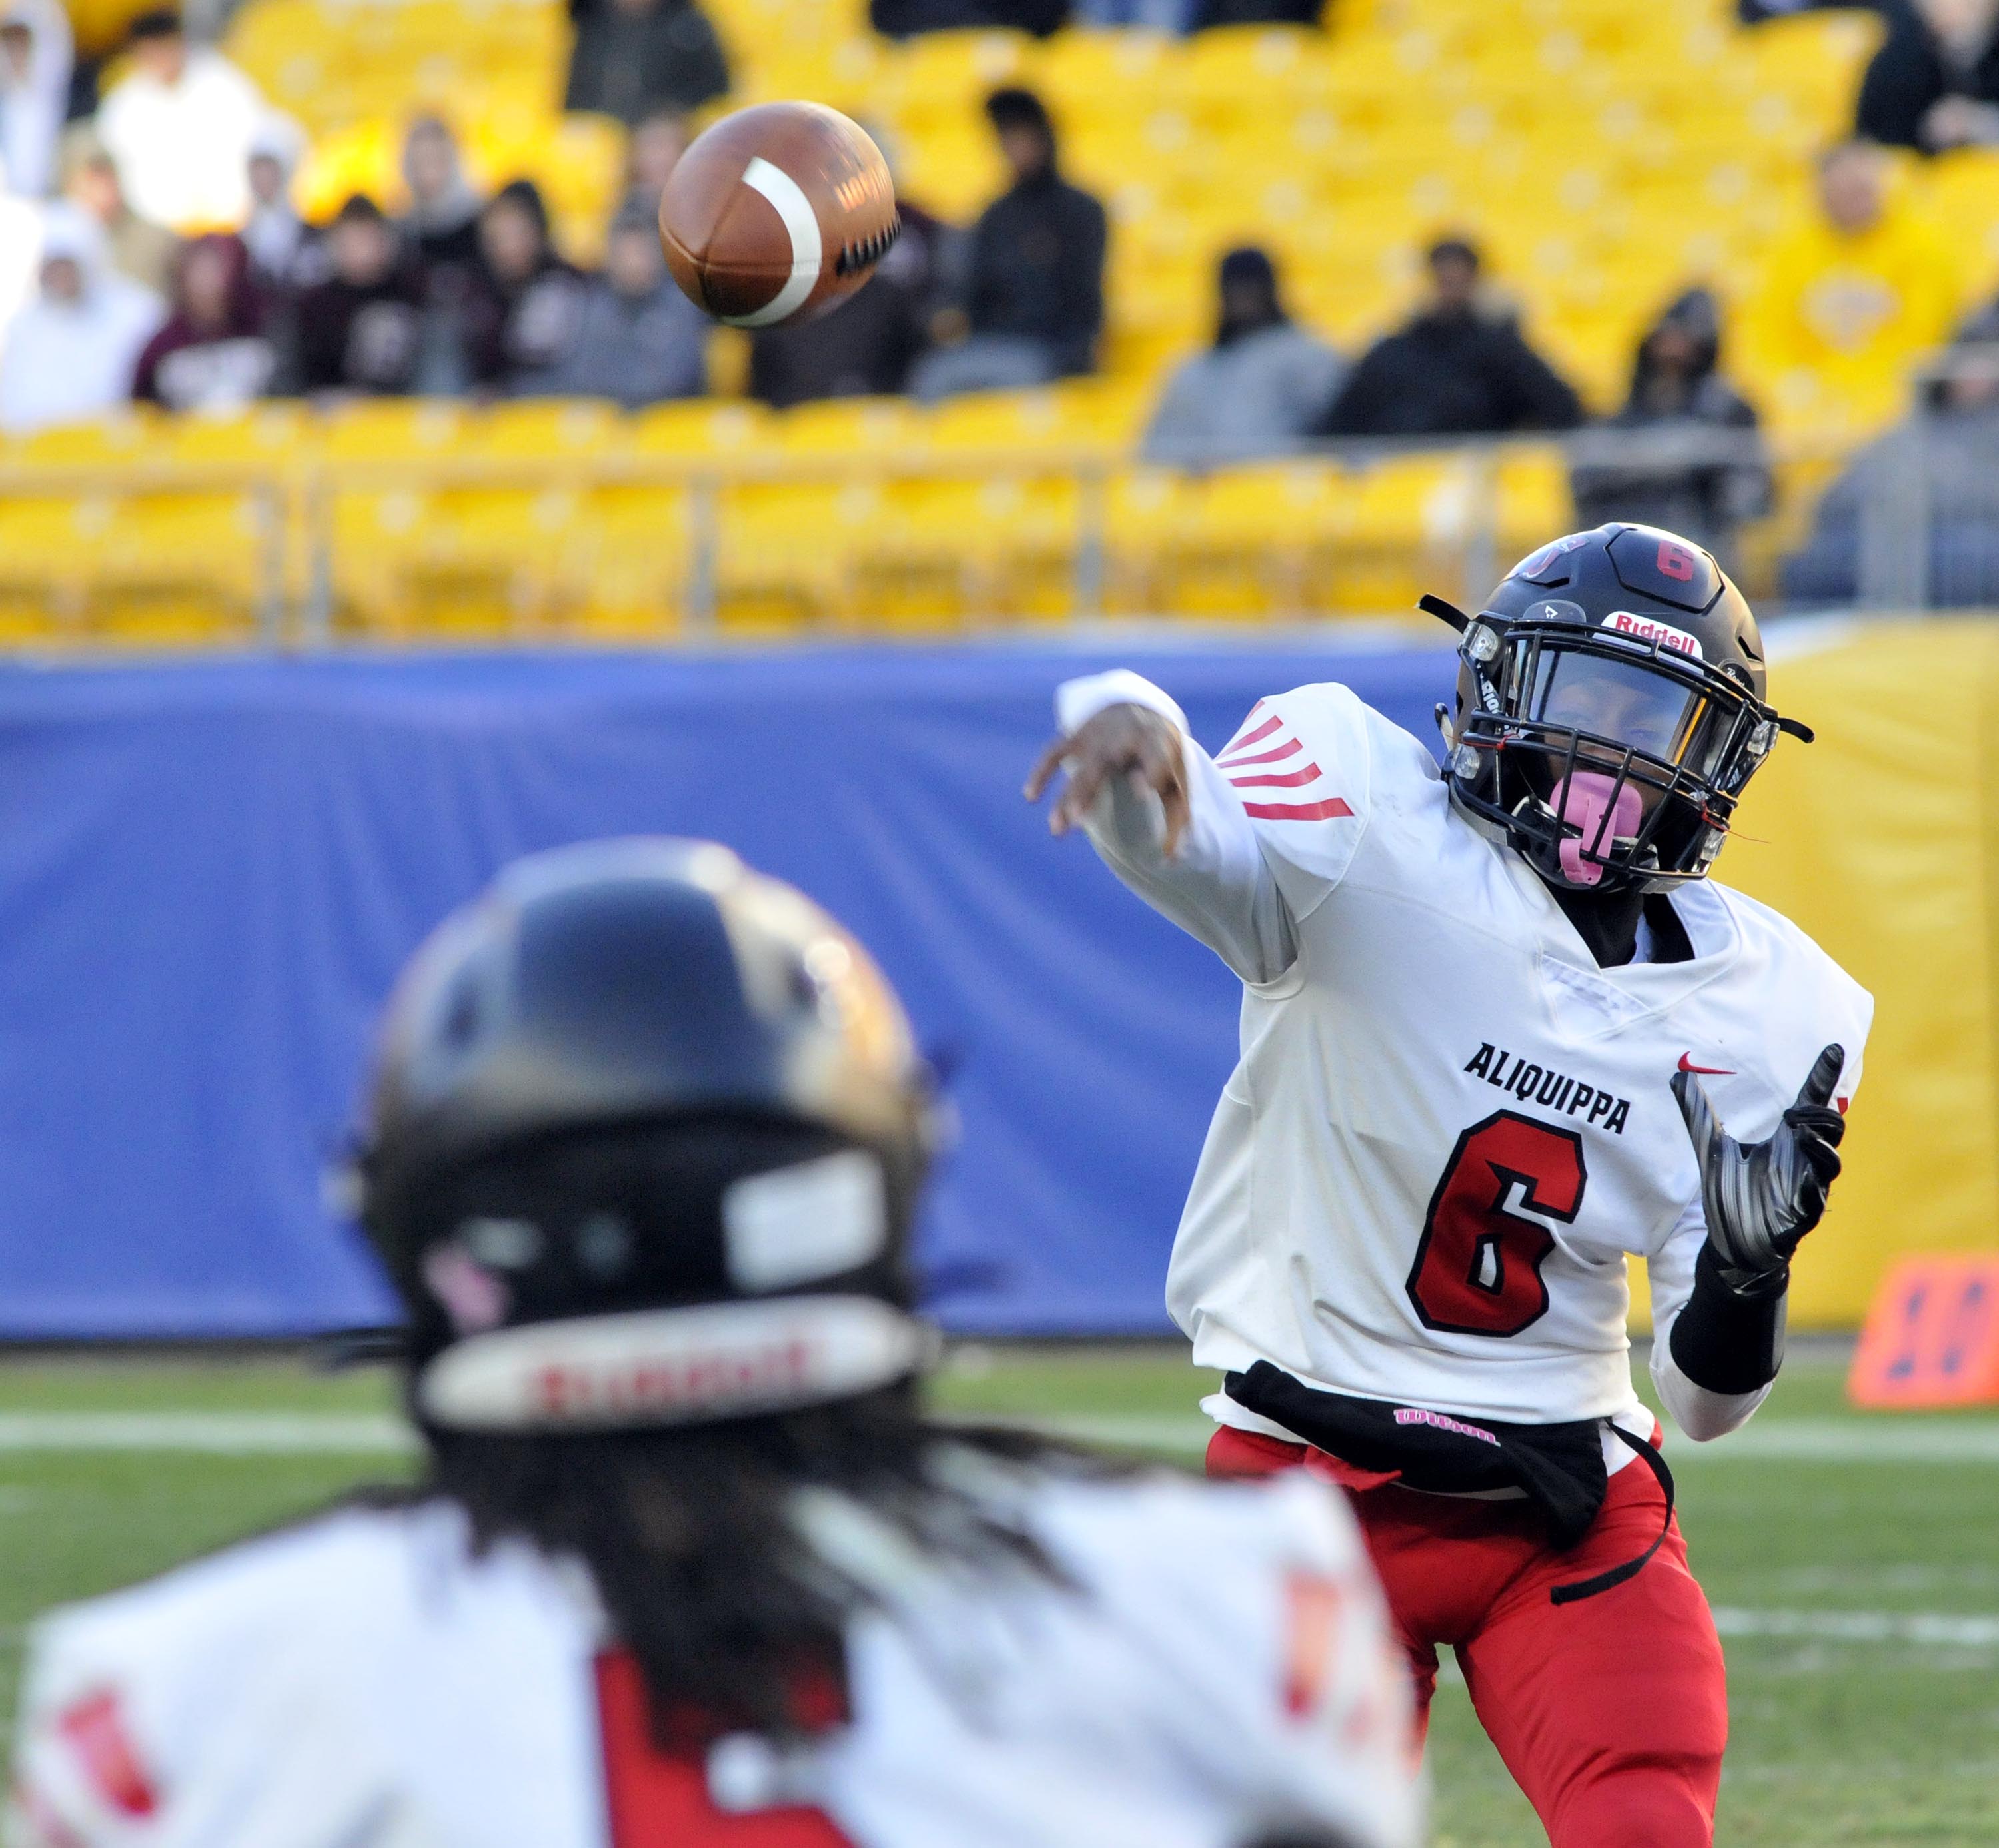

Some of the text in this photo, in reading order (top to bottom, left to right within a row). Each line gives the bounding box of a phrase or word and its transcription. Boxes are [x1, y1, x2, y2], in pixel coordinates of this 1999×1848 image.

[1657, 540, 1695, 582] 6
[1615, 614, 1695, 655] Riddell
[1464, 1041, 1631, 1135] ALIQUIPPA
[1405, 1108, 1588, 1338] 6
[1393, 1408, 1501, 1448] Wilson
